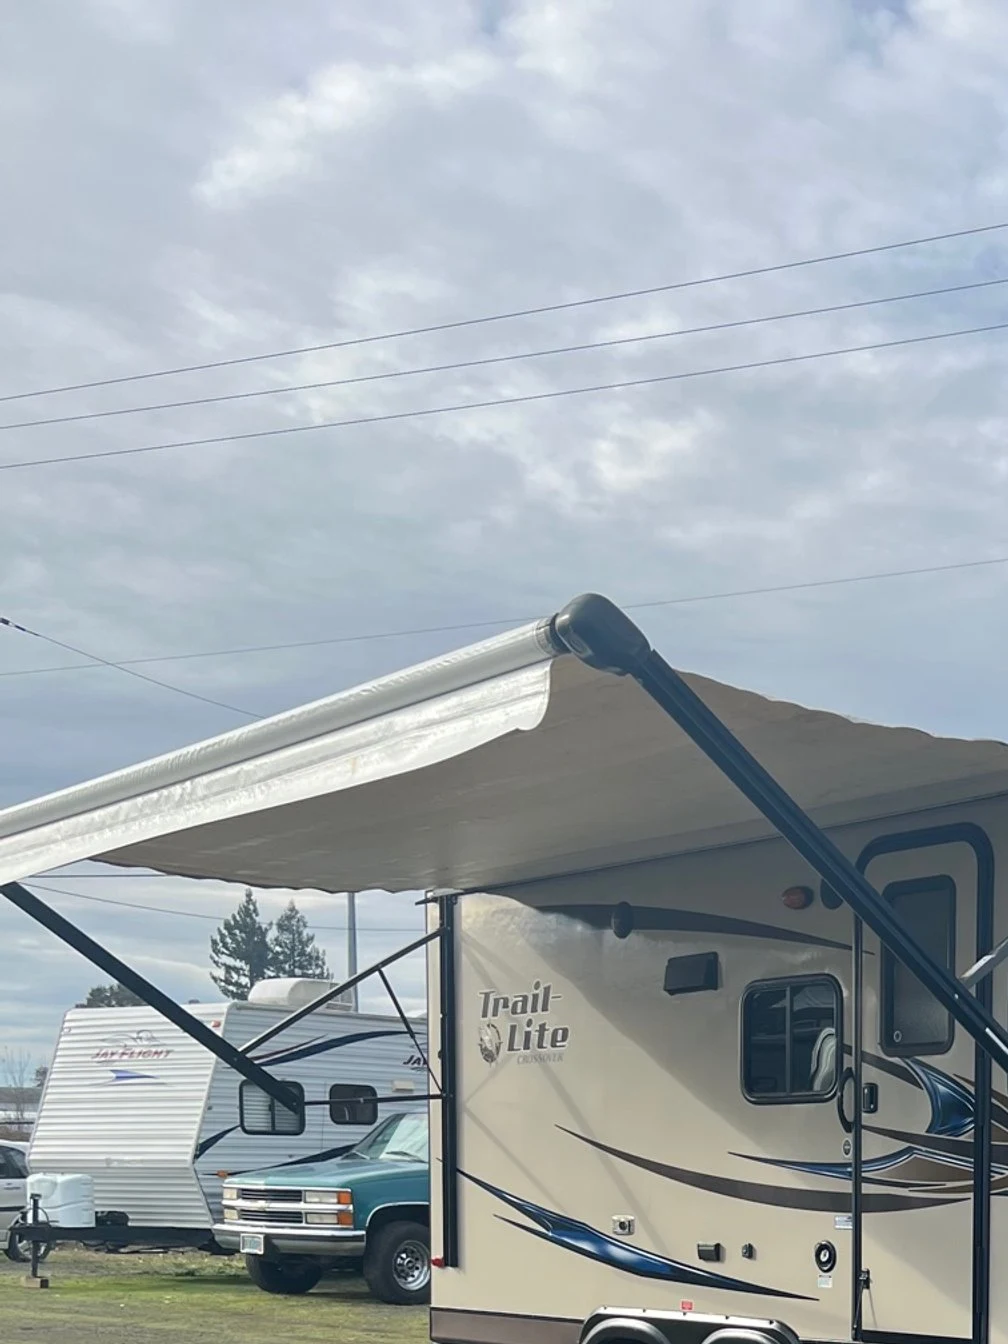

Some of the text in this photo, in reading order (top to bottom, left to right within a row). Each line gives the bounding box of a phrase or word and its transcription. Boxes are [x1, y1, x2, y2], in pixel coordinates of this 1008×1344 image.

[479, 980, 562, 1018] Trail-
[507, 1018, 569, 1051] Lite
[119, 1047, 174, 1059] FLIGHT
